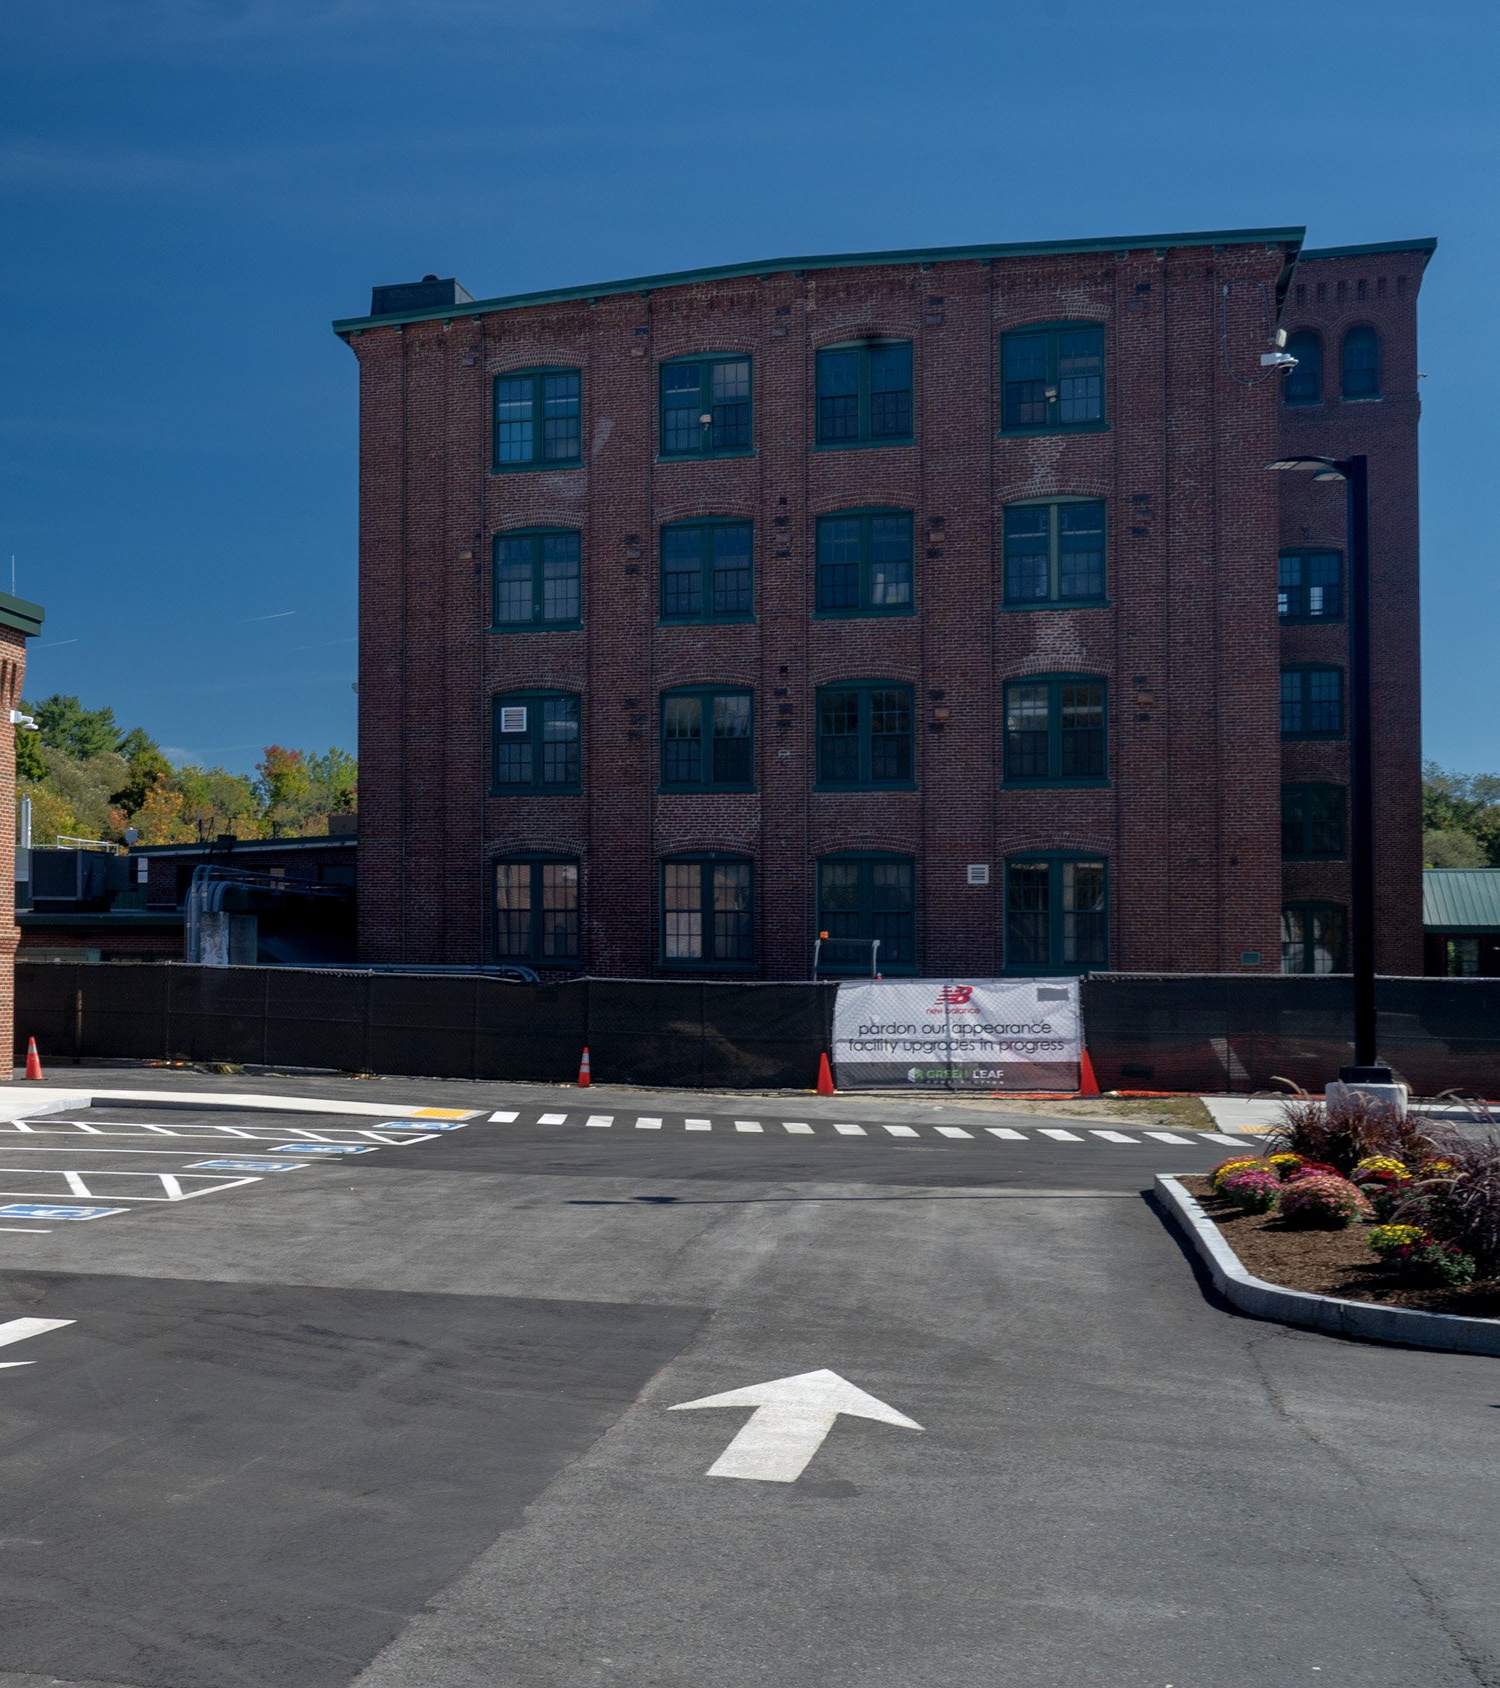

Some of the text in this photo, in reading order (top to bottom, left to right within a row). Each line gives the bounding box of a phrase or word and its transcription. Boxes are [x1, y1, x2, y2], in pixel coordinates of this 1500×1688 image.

[944, 1007, 980, 1015] balance
[859, 1022, 1052, 1037] pardon our appearance
[849, 1038, 1065, 1054] facility upgrades in progress
[926, 1069, 1004, 1079] GREEN LEAF
